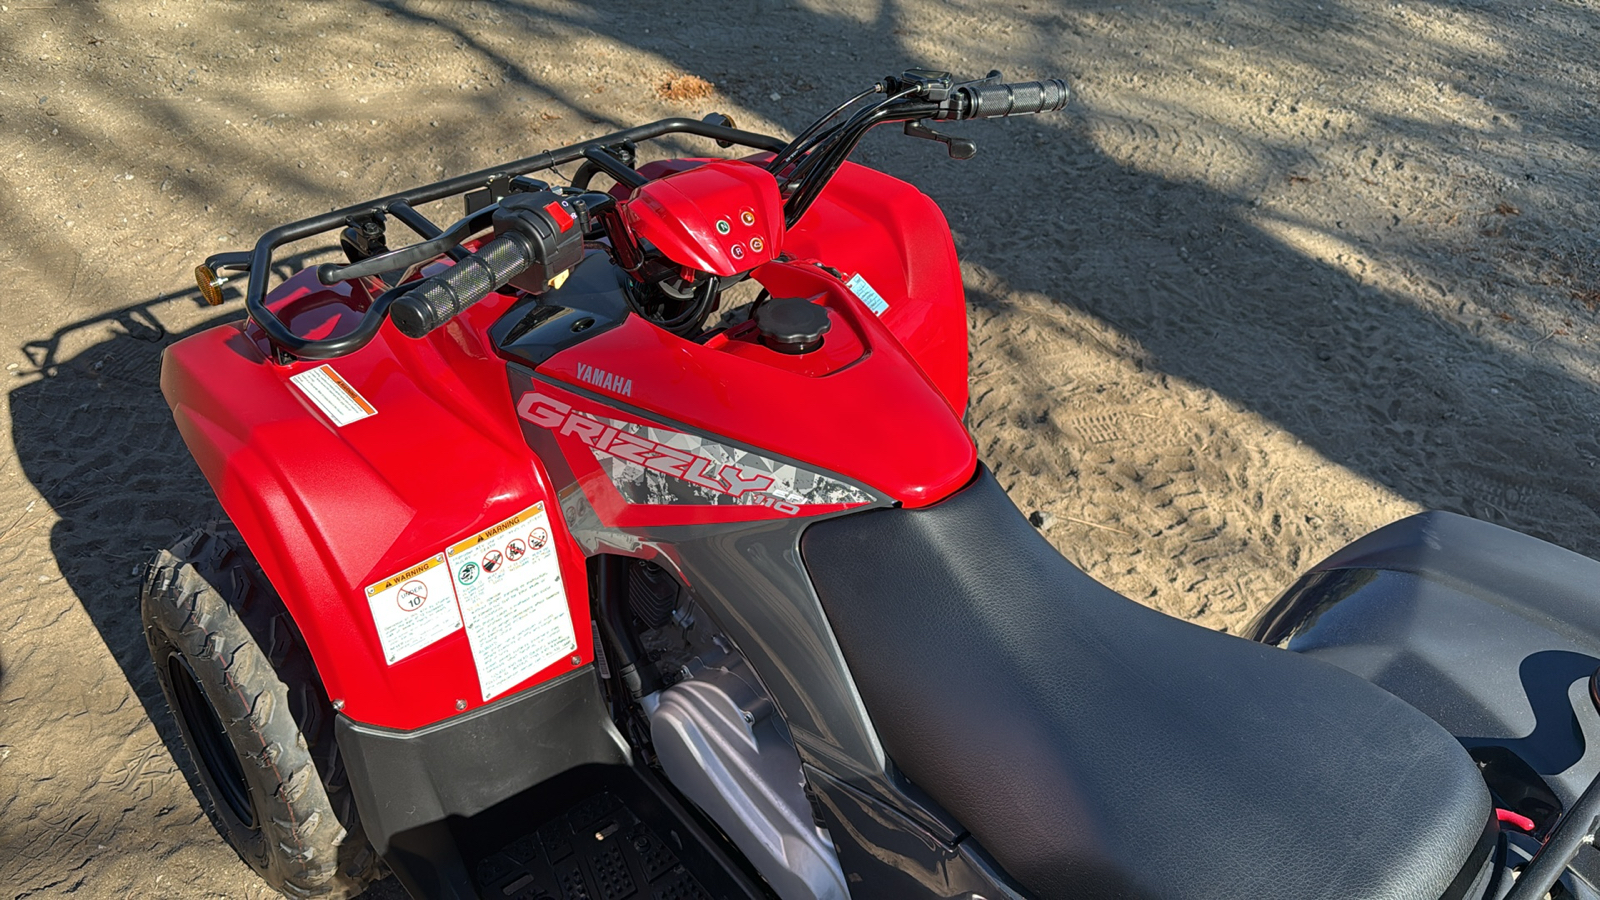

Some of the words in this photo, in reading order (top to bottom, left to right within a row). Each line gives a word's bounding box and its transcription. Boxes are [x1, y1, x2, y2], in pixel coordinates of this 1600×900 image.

[577, 362, 633, 398] YAMAHA
[516, 391, 775, 498] GRIZZLY
[753, 493, 800, 516] 110
[485, 516, 520, 538] WARNING
[393, 563, 430, 584] WARNING
[400, 585, 423, 600] UNDER
[408, 597, 421, 608] 10
